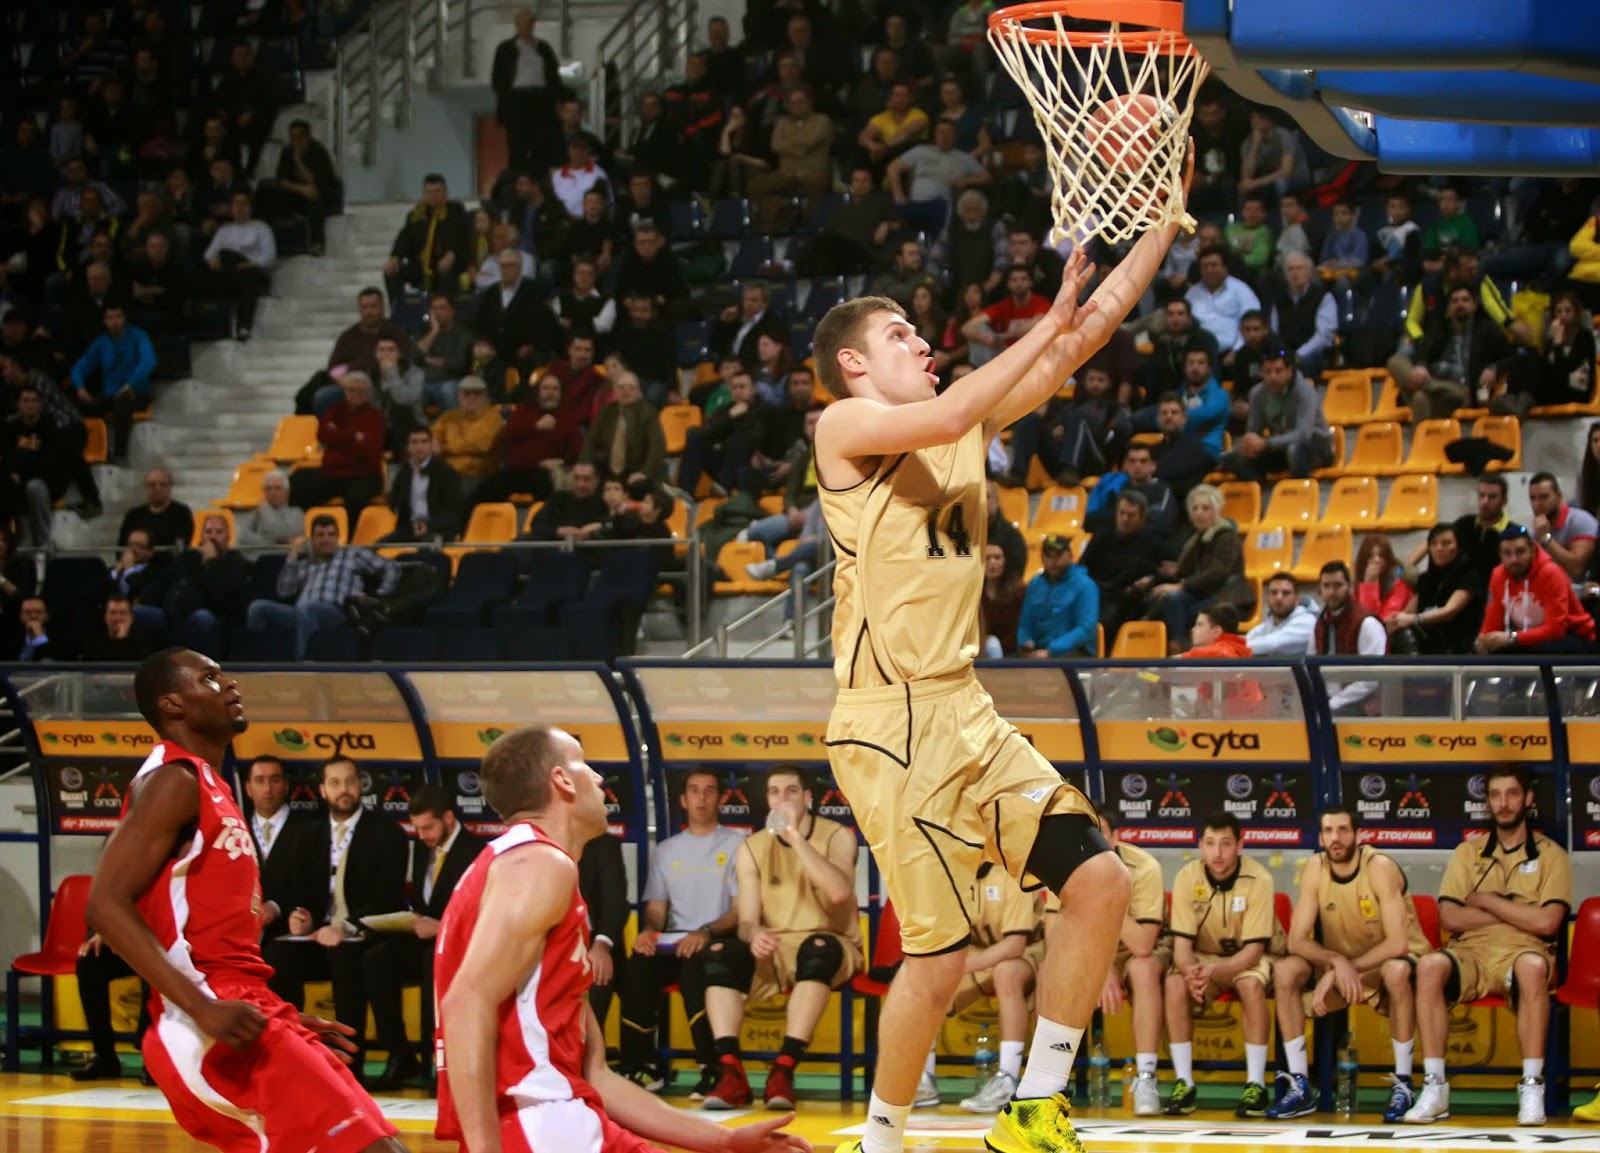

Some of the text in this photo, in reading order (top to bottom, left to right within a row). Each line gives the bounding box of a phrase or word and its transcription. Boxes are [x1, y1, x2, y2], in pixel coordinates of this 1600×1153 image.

[924, 503, 972, 558] 14
[63, 733, 95, 748] cyta
[122, 733, 154, 748] cyta
[314, 731, 376, 755] cyta
[687, 734, 723, 749] cyta
[753, 734, 789, 749] cyta
[1191, 729, 1261, 757] cyta
[1368, 735, 1406, 751] cyta
[1439, 735, 1477, 750] cyta
[1509, 734, 1547, 749] cyta
[1119, 799, 1152, 811] BASKET
[1223, 799, 1257, 811] BASKET
[1357, 800, 1391, 812] BASKET
